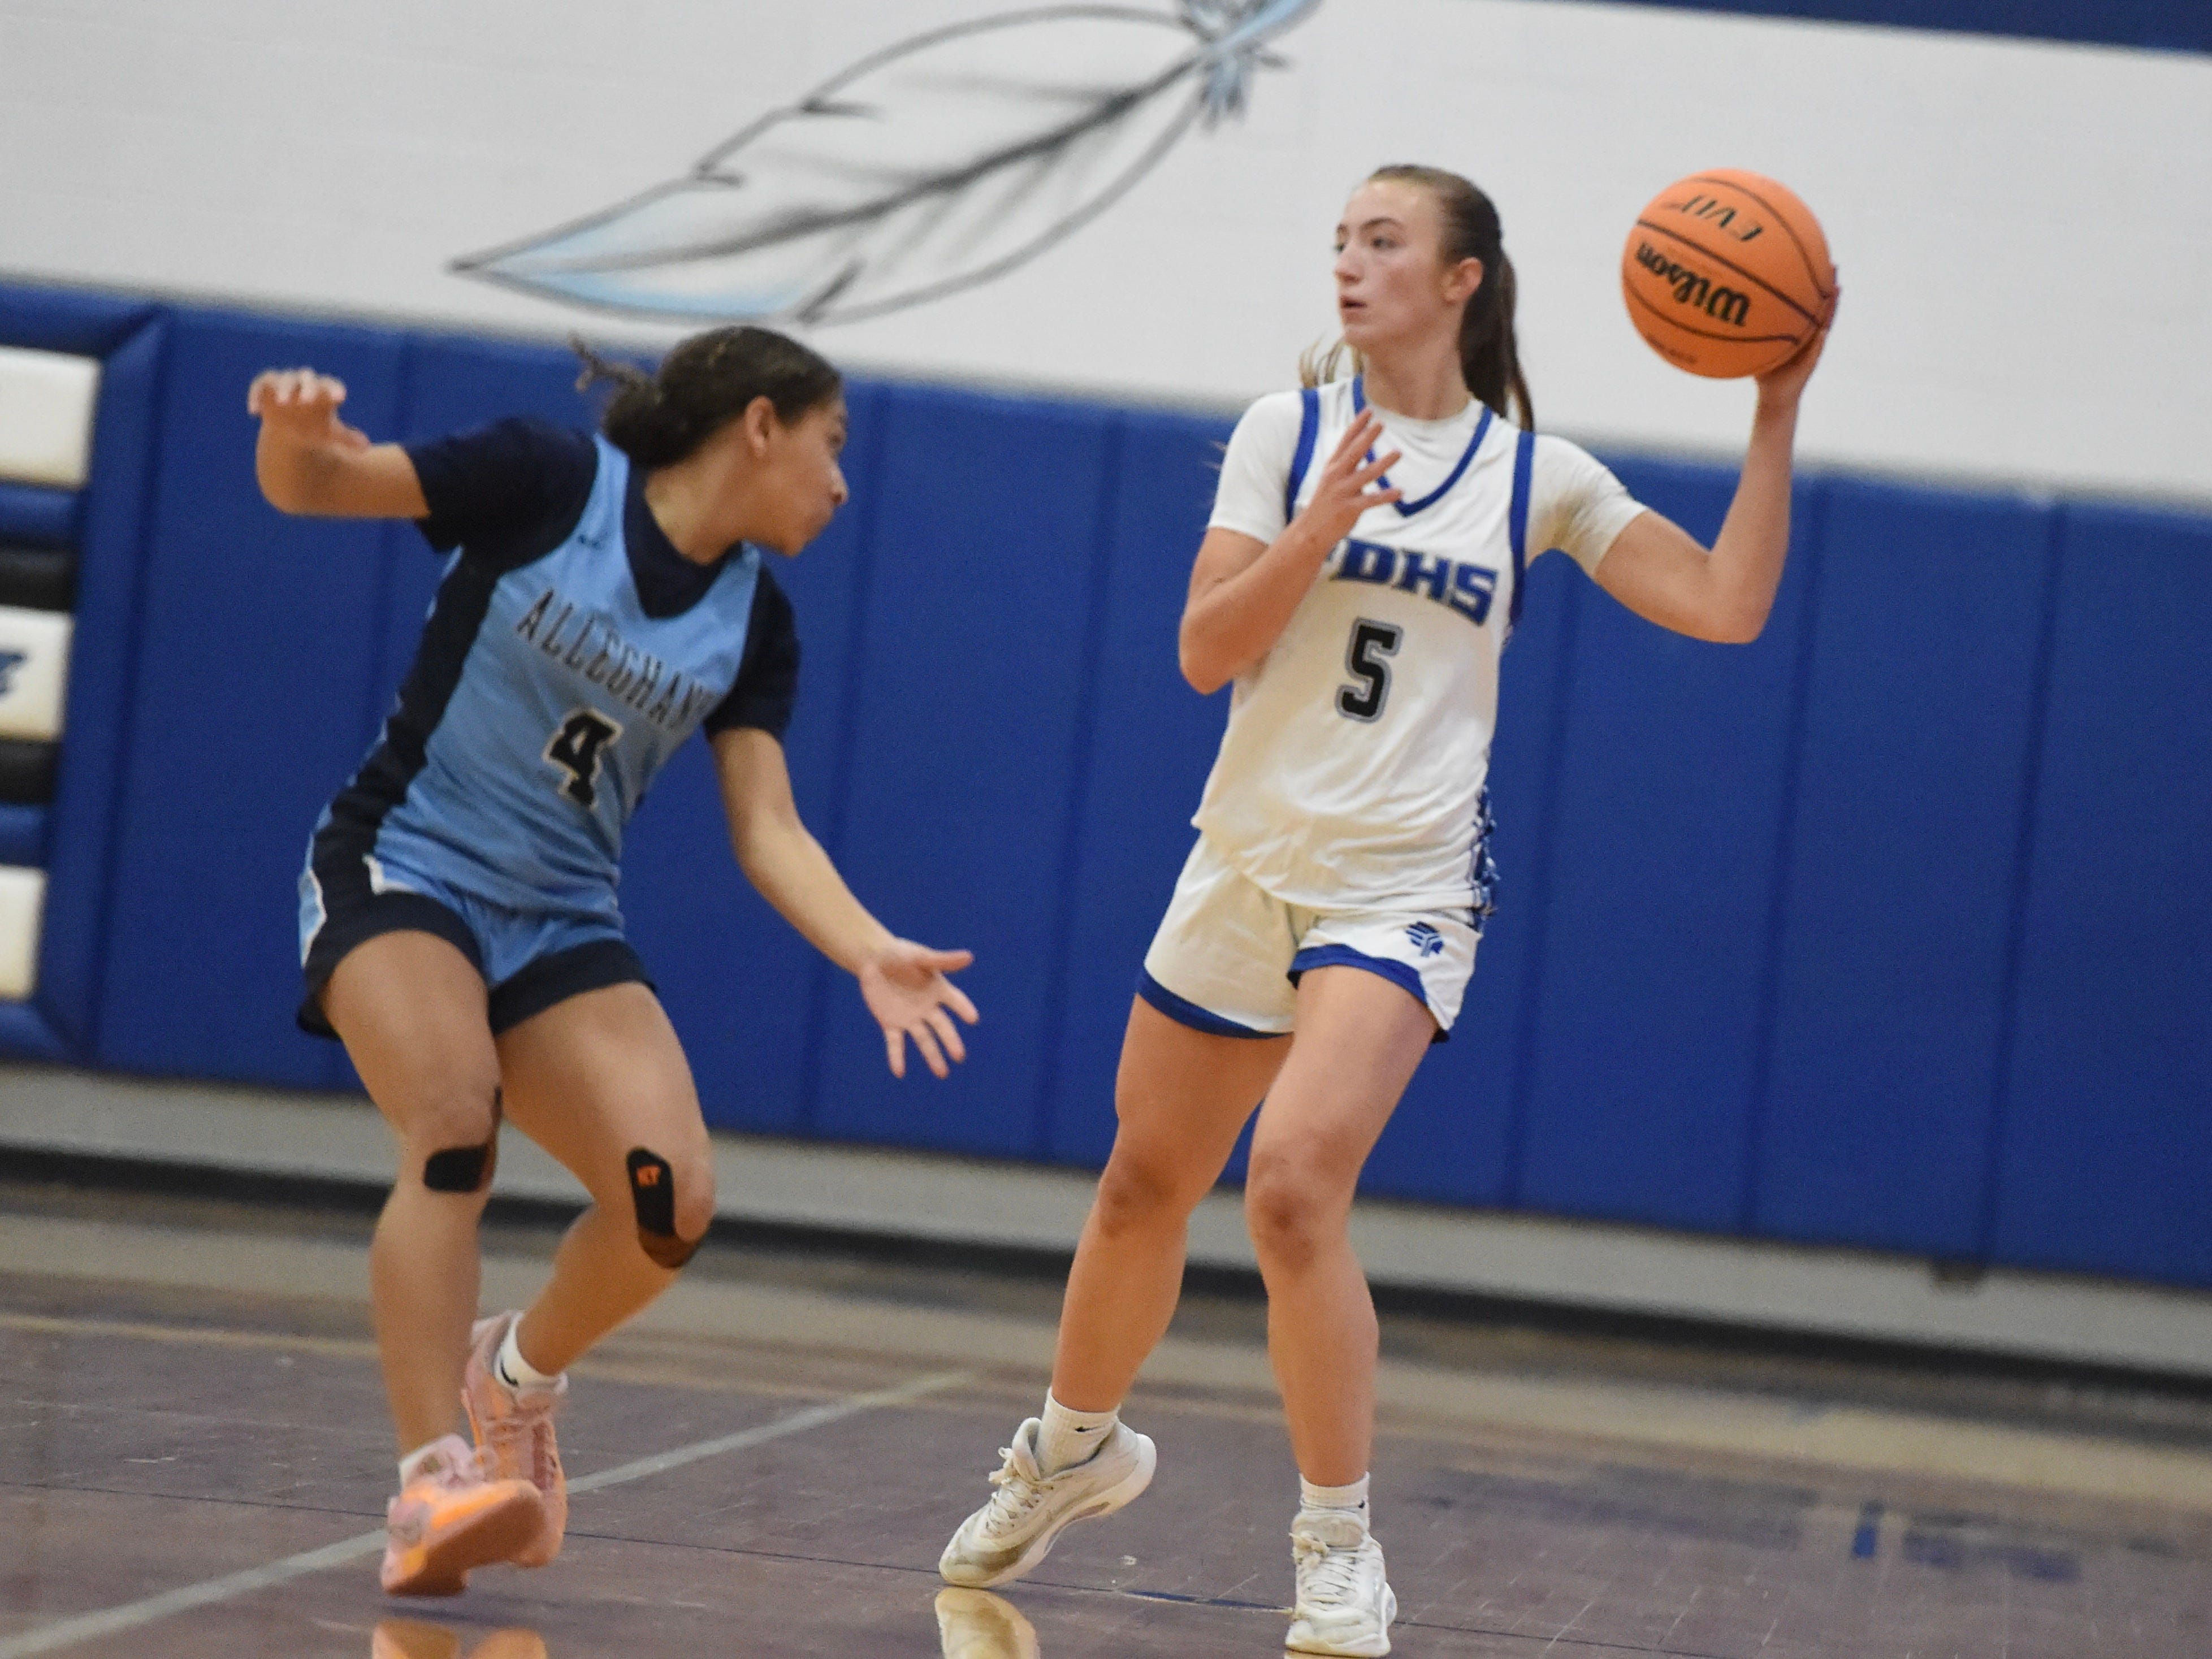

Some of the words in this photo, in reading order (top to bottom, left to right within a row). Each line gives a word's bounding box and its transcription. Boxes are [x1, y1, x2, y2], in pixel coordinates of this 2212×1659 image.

[1635, 241, 1751, 327] Wilson
[1326, 537, 1498, 627] DHS
[517, 589, 705, 728] ALLEGHAN
[1335, 617, 1404, 724] 5
[542, 705, 624, 814] 4
